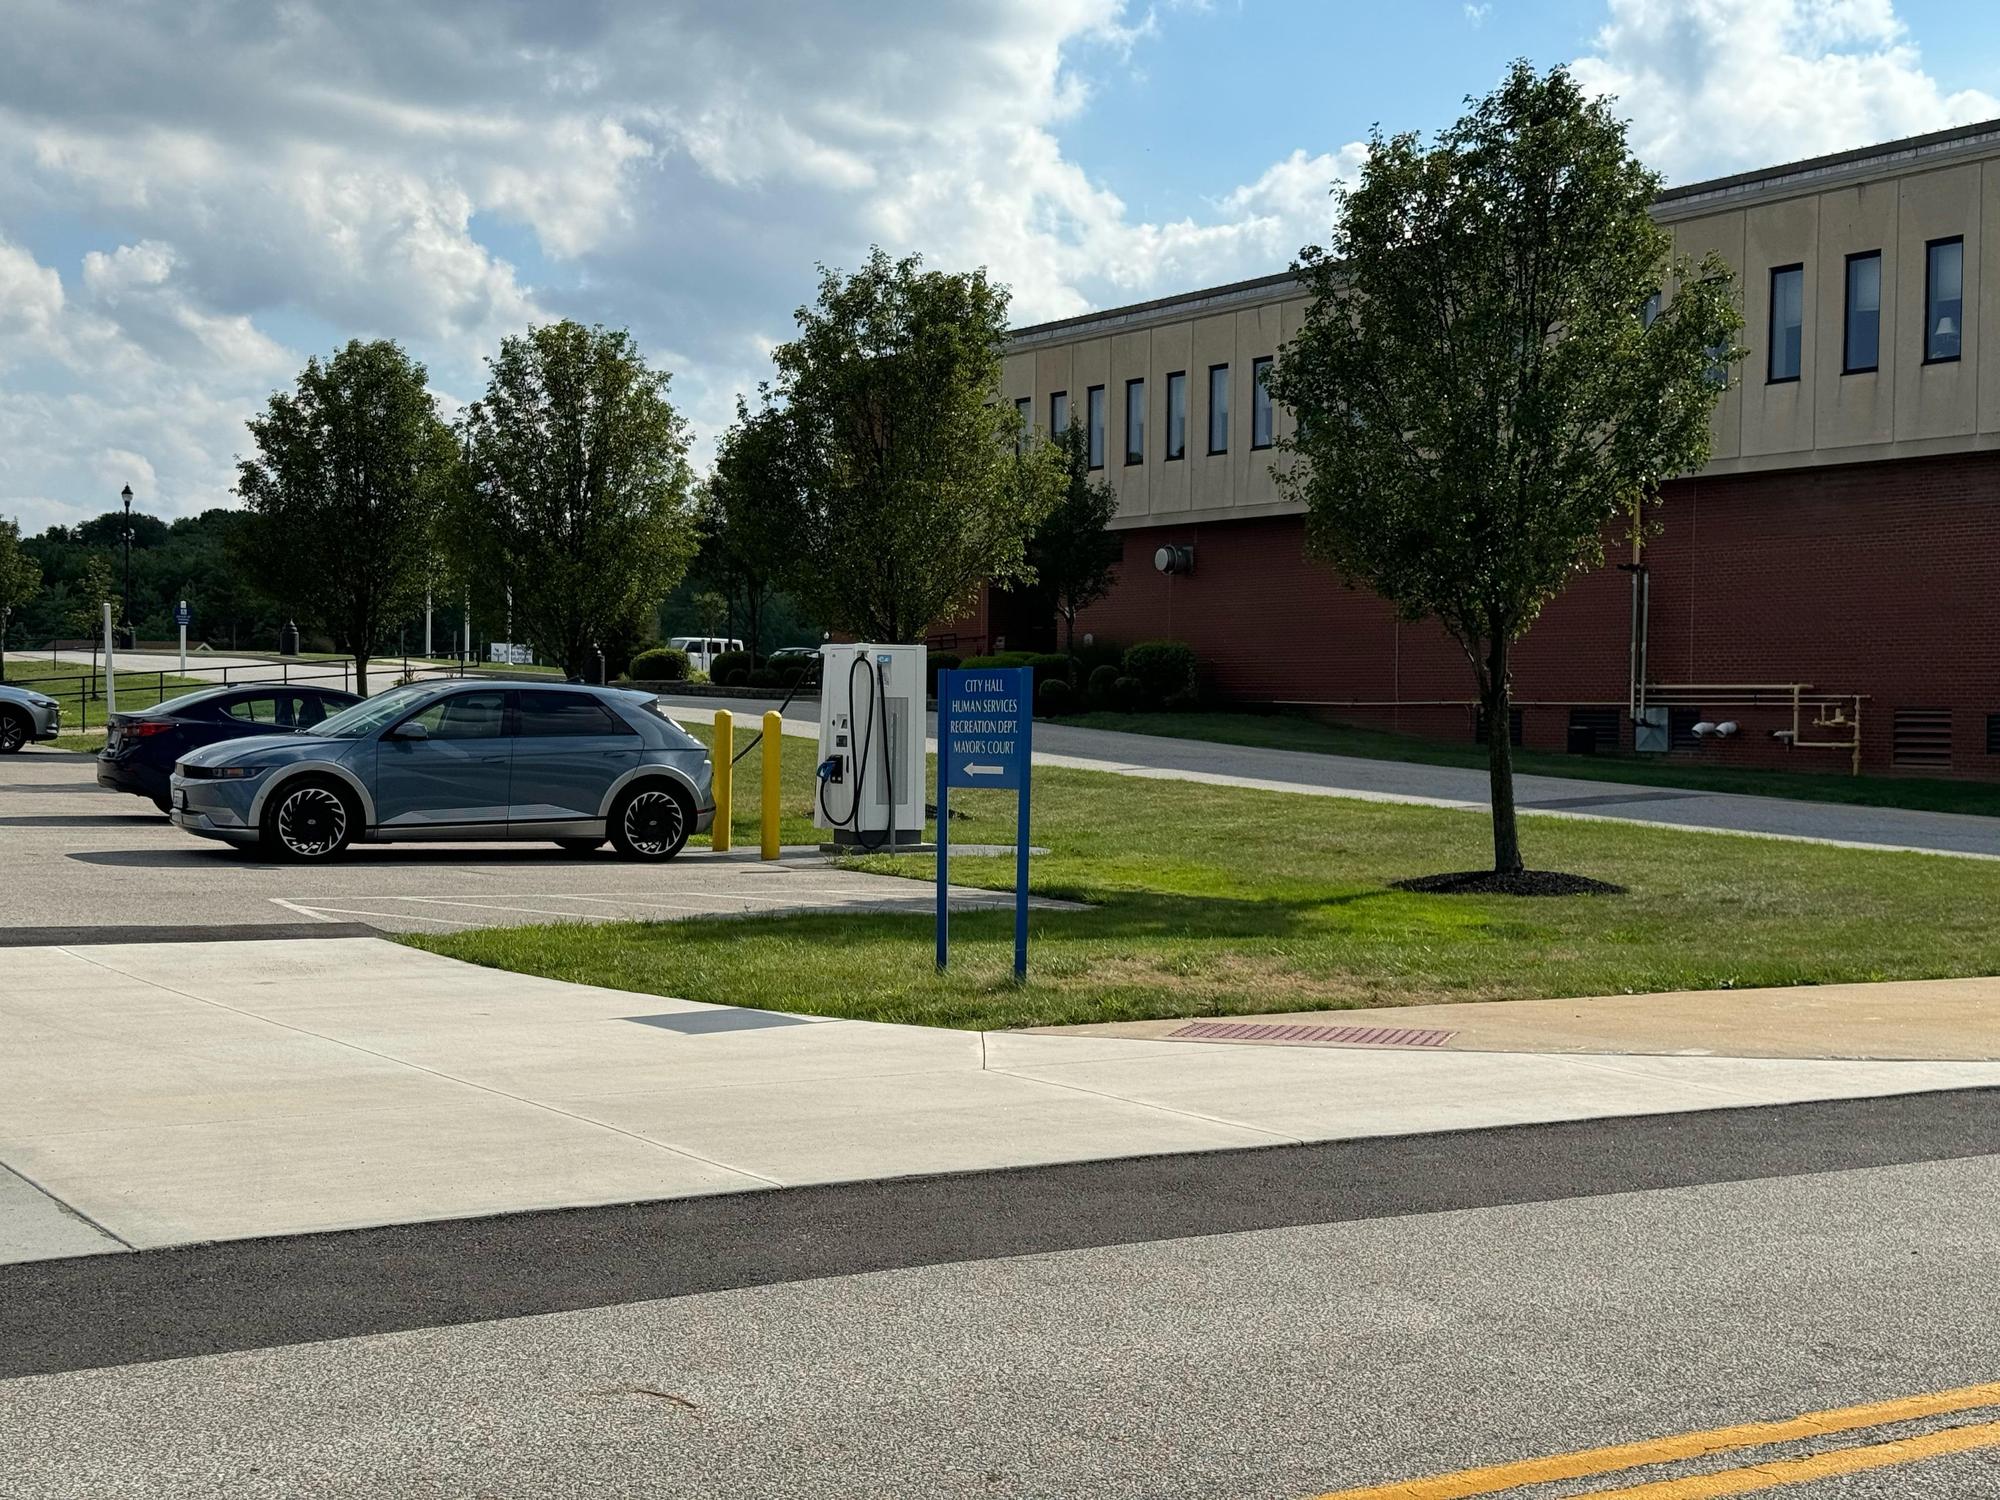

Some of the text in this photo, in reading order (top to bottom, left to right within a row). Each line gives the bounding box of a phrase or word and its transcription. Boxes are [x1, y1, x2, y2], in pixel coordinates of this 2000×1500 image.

[965, 679, 1004, 692] CITY HALL
[952, 699, 1017, 712] HUMAN SERVICES
[950, 719, 1018, 733] RECREATION DEPT.
[987, 740, 1015, 754] COURT
